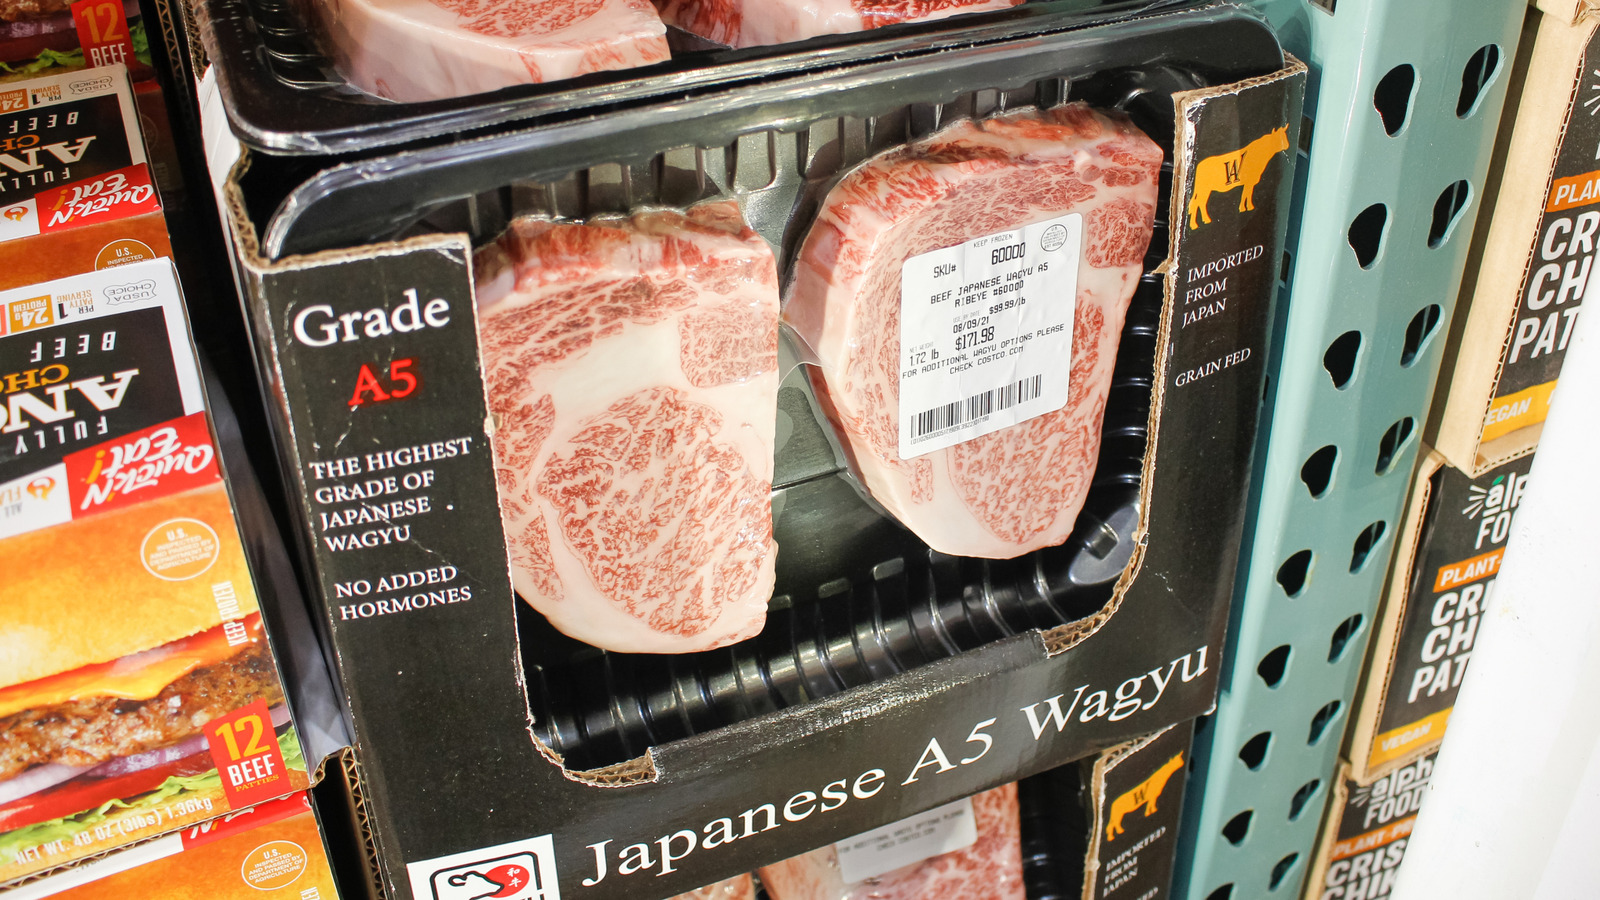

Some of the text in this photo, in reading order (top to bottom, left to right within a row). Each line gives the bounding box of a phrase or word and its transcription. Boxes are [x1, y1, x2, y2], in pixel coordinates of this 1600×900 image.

[81, 2, 123, 43] 12
[90, 43, 126, 68] BEEF
[74, 78, 110, 88] CHOICE
[78, 84, 107, 92] USDA
[0, 98, 24, 111] 24
[9, 112, 79, 134] BEEF
[974, 234, 1014, 248] KEEP FROZEN
[1541, 210, 1600, 261] CR
[108, 254, 144, 266] INSPECTED
[116, 248, 132, 257] U.S.
[934, 242, 1026, 278] SKU# 60000
[1186, 244, 1264, 284] IMPORTED
[57, 290, 92, 303] SERVING
[108, 283, 152, 295] CHOICE
[114, 291, 150, 302] USDA
[930, 262, 1048, 304] BEEF JAPANESE WAGYU A5
[955, 280, 1024, 308] RIBEYE #60000
[1184, 278, 1228, 305] FROM
[1527, 255, 1593, 311] CH
[13, 299, 47, 312] PROTEIN
[58, 303, 68, 319] 1
[70, 298, 93, 308] PATTY
[78, 304, 94, 314] PER
[293, 288, 450, 348] Grade
[989, 298, 1026, 314] $99.99/lb
[1181, 298, 1228, 329] JAPAN
[952, 316, 990, 334] 08/09/21
[955, 326, 995, 351] $171.98
[1508, 304, 1582, 364] PAT
[30, 331, 116, 362] BEEF
[902, 324, 1065, 380] FOR ADDITIONAL WAGYU OPTIONS PLEASE
[910, 349, 939, 367] 1.72 lb
[950, 346, 1024, 375] CHECK COSTCO.COM
[0, 364, 70, 394] CH
[348, 358, 418, 406] A5
[1174, 347, 1252, 388] GRAIN FED
[0, 368, 140, 435] AN
[15, 416, 109, 456] FULLY
[309, 436, 472, 481] THE HIGHEST
[314, 469, 435, 505] GRADE OF
[319, 496, 432, 532] JAPANESE
[166, 528, 188, 542] U.S.
[324, 524, 411, 553] WAGYU
[1474, 511, 1518, 550] FO
[334, 566, 458, 598] NO ADDED
[211, 580, 248, 646] KEEP FROZEN
[339, 586, 472, 622] HORMONES
[1420, 614, 1481, 664] CH
[1407, 652, 1473, 704] PAT
[215, 714, 270, 762] 12
[1381, 722, 1432, 752] VEGAN
[228, 754, 275, 787] BEEF
[582, 768, 886, 886] Japanese
[900, 717, 997, 786] A5
[1020, 645, 1208, 740] Wagyu
[235, 774, 280, 792] PATTIES
[14, 846, 41, 865] NET
[43, 838, 70, 856] WT.
[73, 830, 92, 848] 48
[94, 824, 115, 842] OZ
[116, 809, 163, 836] (3lbs)
[166, 796, 214, 821] 1.36kg
[254, 852, 292, 868] INSPECTED
[263, 848, 281, 860] U.S.
[1106, 826, 1166, 872] IMPORTED
[1326, 839, 1407, 888] CRIS
[249, 866, 262, 876] AND
[262, 858, 290, 872] PASSED
[249, 862, 294, 880] DEPARTMENT
[254, 865, 300, 884] AGRICULTURE
